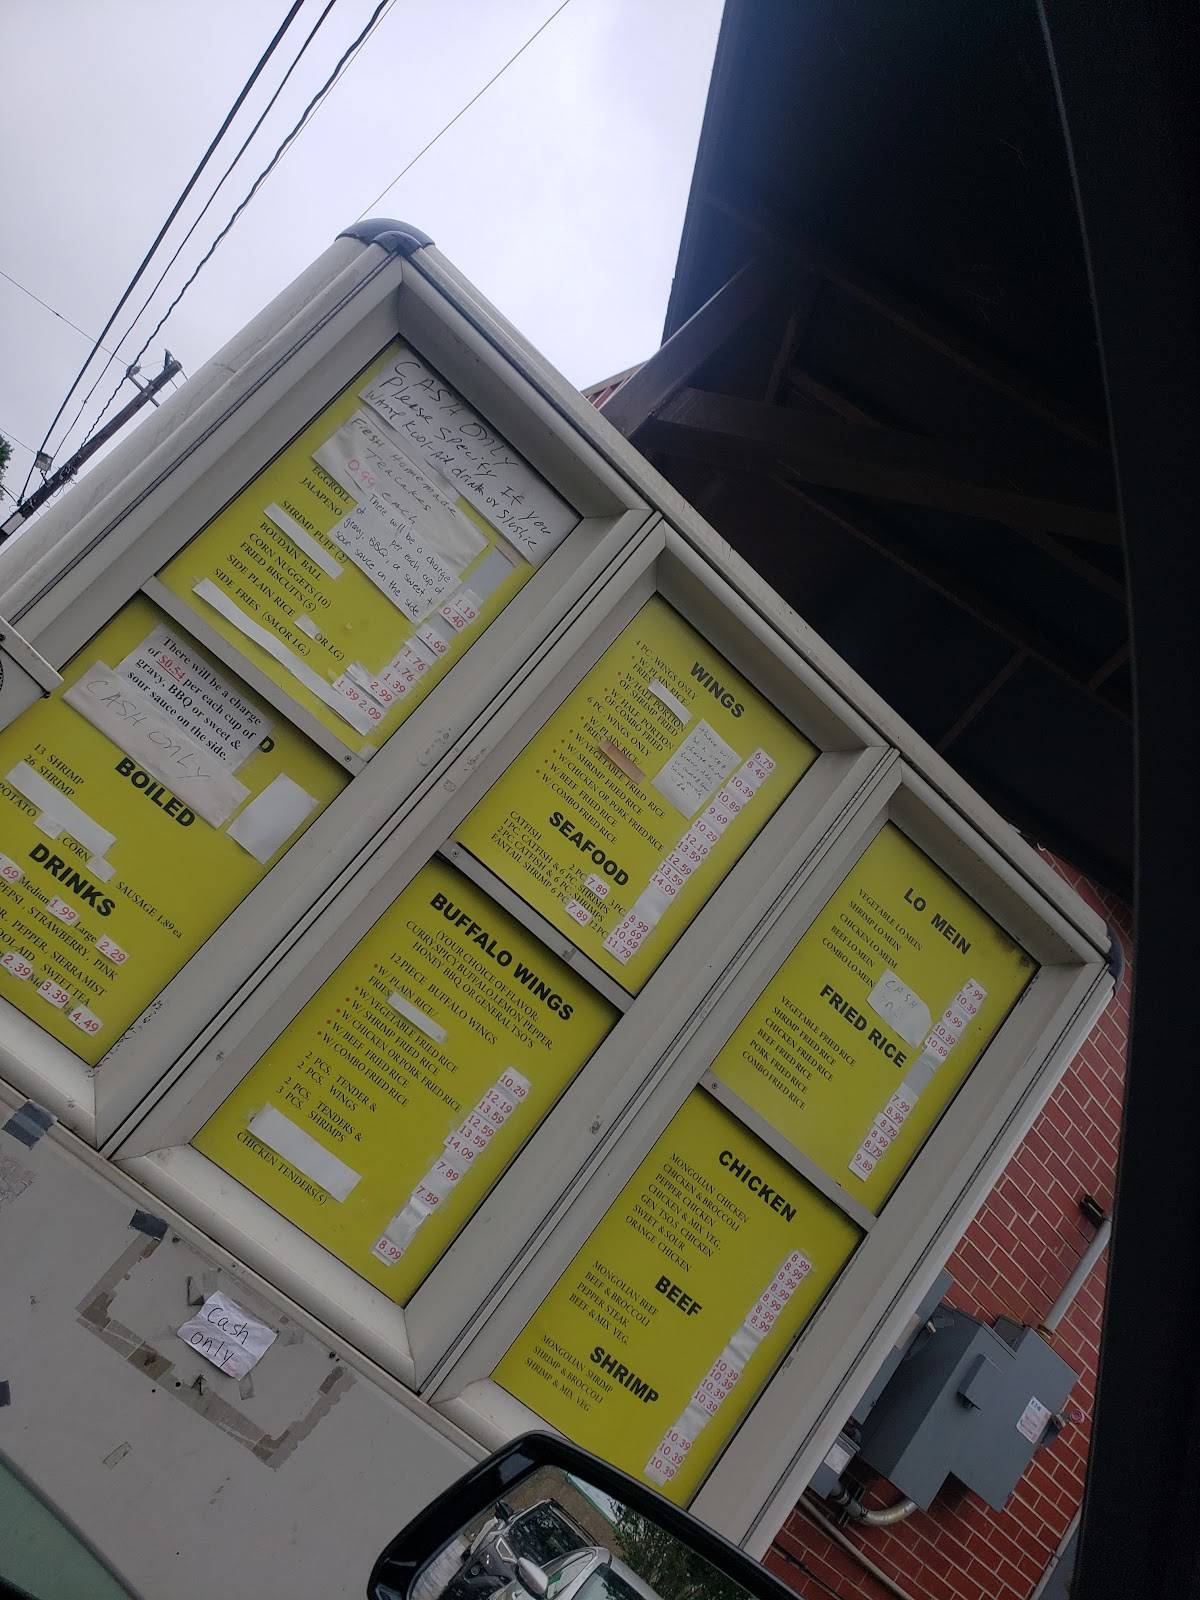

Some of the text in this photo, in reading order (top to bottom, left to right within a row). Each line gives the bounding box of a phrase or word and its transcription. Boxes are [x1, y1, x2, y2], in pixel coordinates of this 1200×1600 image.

[380, 376, 432, 424] Please
[519, 510, 550, 535] you
[300, 476, 343, 517] JALAPENO
[310, 465, 352, 504] EGGROLL
[280, 499, 337, 552] SHRIMP PUFF
[238, 541, 267, 567] FRIED
[247, 532, 275, 558] CORN
[258, 521, 322, 580] BOUDAIN BALL
[420, 554, 453, 586] charge
[212, 568, 261, 612] SIDE FRIES
[225, 553, 295, 617] SIDE PLAIN RICE
[386, 580, 403, 596] the
[454, 598, 476, 620] 1.19
[424, 631, 447, 654] 1.69
[392, 660, 416, 683] 1.76
[402, 649, 426, 671] 1.76
[159, 635, 264, 726] There will be a charge
[382, 672, 406, 694] 1.39
[652, 656, 697, 700] WINGS ONLY
[688, 662, 747, 720] WINGS
[146, 644, 256, 741] of $0.54 per each cup of
[335, 678, 382, 721] 1.39 2.09
[369, 680, 393, 703] 2.99
[126, 671, 230, 760] sour sauce on the side.
[165, 683, 194, 709] BBQ
[190, 706, 204, 718] or
[202, 716, 231, 740] sweet
[229, 737, 242, 750] &
[629, 689, 678, 737] SHRIMP FRIED
[605, 713, 651, 757] WINGS ONLY
[33, 743, 85, 786] 13 SHRIMP
[575, 752, 606, 781] SHRIMP
[754, 750, 774, 771] 6.79
[22, 754, 76, 798] 26 SHRIMP
[730, 775, 754, 799] 10.39
[112, 756, 199, 828] BOILED
[717, 790, 741, 814] 10.89
[508, 809, 543, 841] CATFISH
[707, 806, 728, 826] 9.69
[545, 809, 632, 887] SEAFOOD
[676, 840, 701, 864] 13.59
[684, 833, 709, 856] 12.19
[489, 832, 552, 888] FANTAIL SHRIMP
[667, 853, 692, 876] 12.59
[26, 842, 119, 918] DRINKS
[586, 876, 608, 897] 7.89
[651, 873, 676, 896] 14.09
[48, 898, 76, 921] 1.99
[114, 880, 157, 916] SAUSAGE
[857, 888, 896, 927] VEGETABLE
[567, 902, 589, 922] 7.89
[627, 914, 649, 934] 8.99
[903, 886, 971, 955] LO MEIN
[606, 936, 632, 959] 11.79
[613, 927, 638, 950] 10.69
[98, 940, 126, 964] 2.29
[411, 941, 464, 987] HONEY BBQ
[427, 892, 576, 1021] BUFFALO WINGS
[2, 953, 32, 978] 2.39
[92, 958, 118, 980] PINK
[460, 951, 497, 984] CHOICE
[39, 980, 69, 1005] 3.39
[398, 960, 498, 1045] PIECE BUFFALO WINGS
[956, 993, 977, 1015] 10.39
[965, 982, 983, 1001] 7.99
[70, 1009, 99, 1034] 4.49
[779, 995, 820, 1033] VEGETABLE
[818, 983, 869, 1033] FRIED
[866, 1027, 908, 1068] RICE
[944, 1009, 963, 1028] 8.99
[361, 1010, 440, 1076] SHRIMP FRIED RICE
[764, 1017, 797, 1048] CHICKEN
[934, 1024, 956, 1046] 10.39
[749, 1039, 770, 1060] PORK
[926, 1036, 948, 1058] 10.89
[741, 1050, 770, 1077] COMBO
[327, 1085, 358, 1111] WINGS
[334, 1074, 370, 1105] TENDER
[499, 1074, 527, 1098] 10.29
[477, 1100, 505, 1125] 13.59
[485, 1089, 513, 1114] 12.19
[891, 1094, 910, 1113] 7.99
[306, 1110, 346, 1143] SHRIMPS
[315, 1101, 356, 1135] TENDERS
[467, 1113, 494, 1139] 12.59
[879, 1119, 897, 1138] 8.79
[235, 1131, 278, 1166] CHICKEN
[446, 1135, 474, 1160] 14.09
[436, 1161, 459, 1182] 7.89
[854, 1153, 873, 1172] 9.89
[414, 1184, 439, 1207] 7.59
[716, 1147, 797, 1223] CHICKEN
[681, 1195, 716, 1228] CHICKEN
[377, 1239, 402, 1261] 8.99
[624, 1214, 691, 1273] ORANGE CHICKEN
[790, 1253, 810, 1273] 8.99
[654, 1274, 702, 1320] BEEF
[761, 1292, 782, 1313] 8.99
[750, 1314, 770, 1334] 8.99
[190, 1332, 234, 1368] only
[588, 1343, 660, 1409] SHRIMP
[714, 1358, 739, 1382] 10.39
[700, 1378, 725, 1401] 10.39
[666, 1428, 691, 1452] 10.39
[650, 1455, 675, 1479] 10.39
